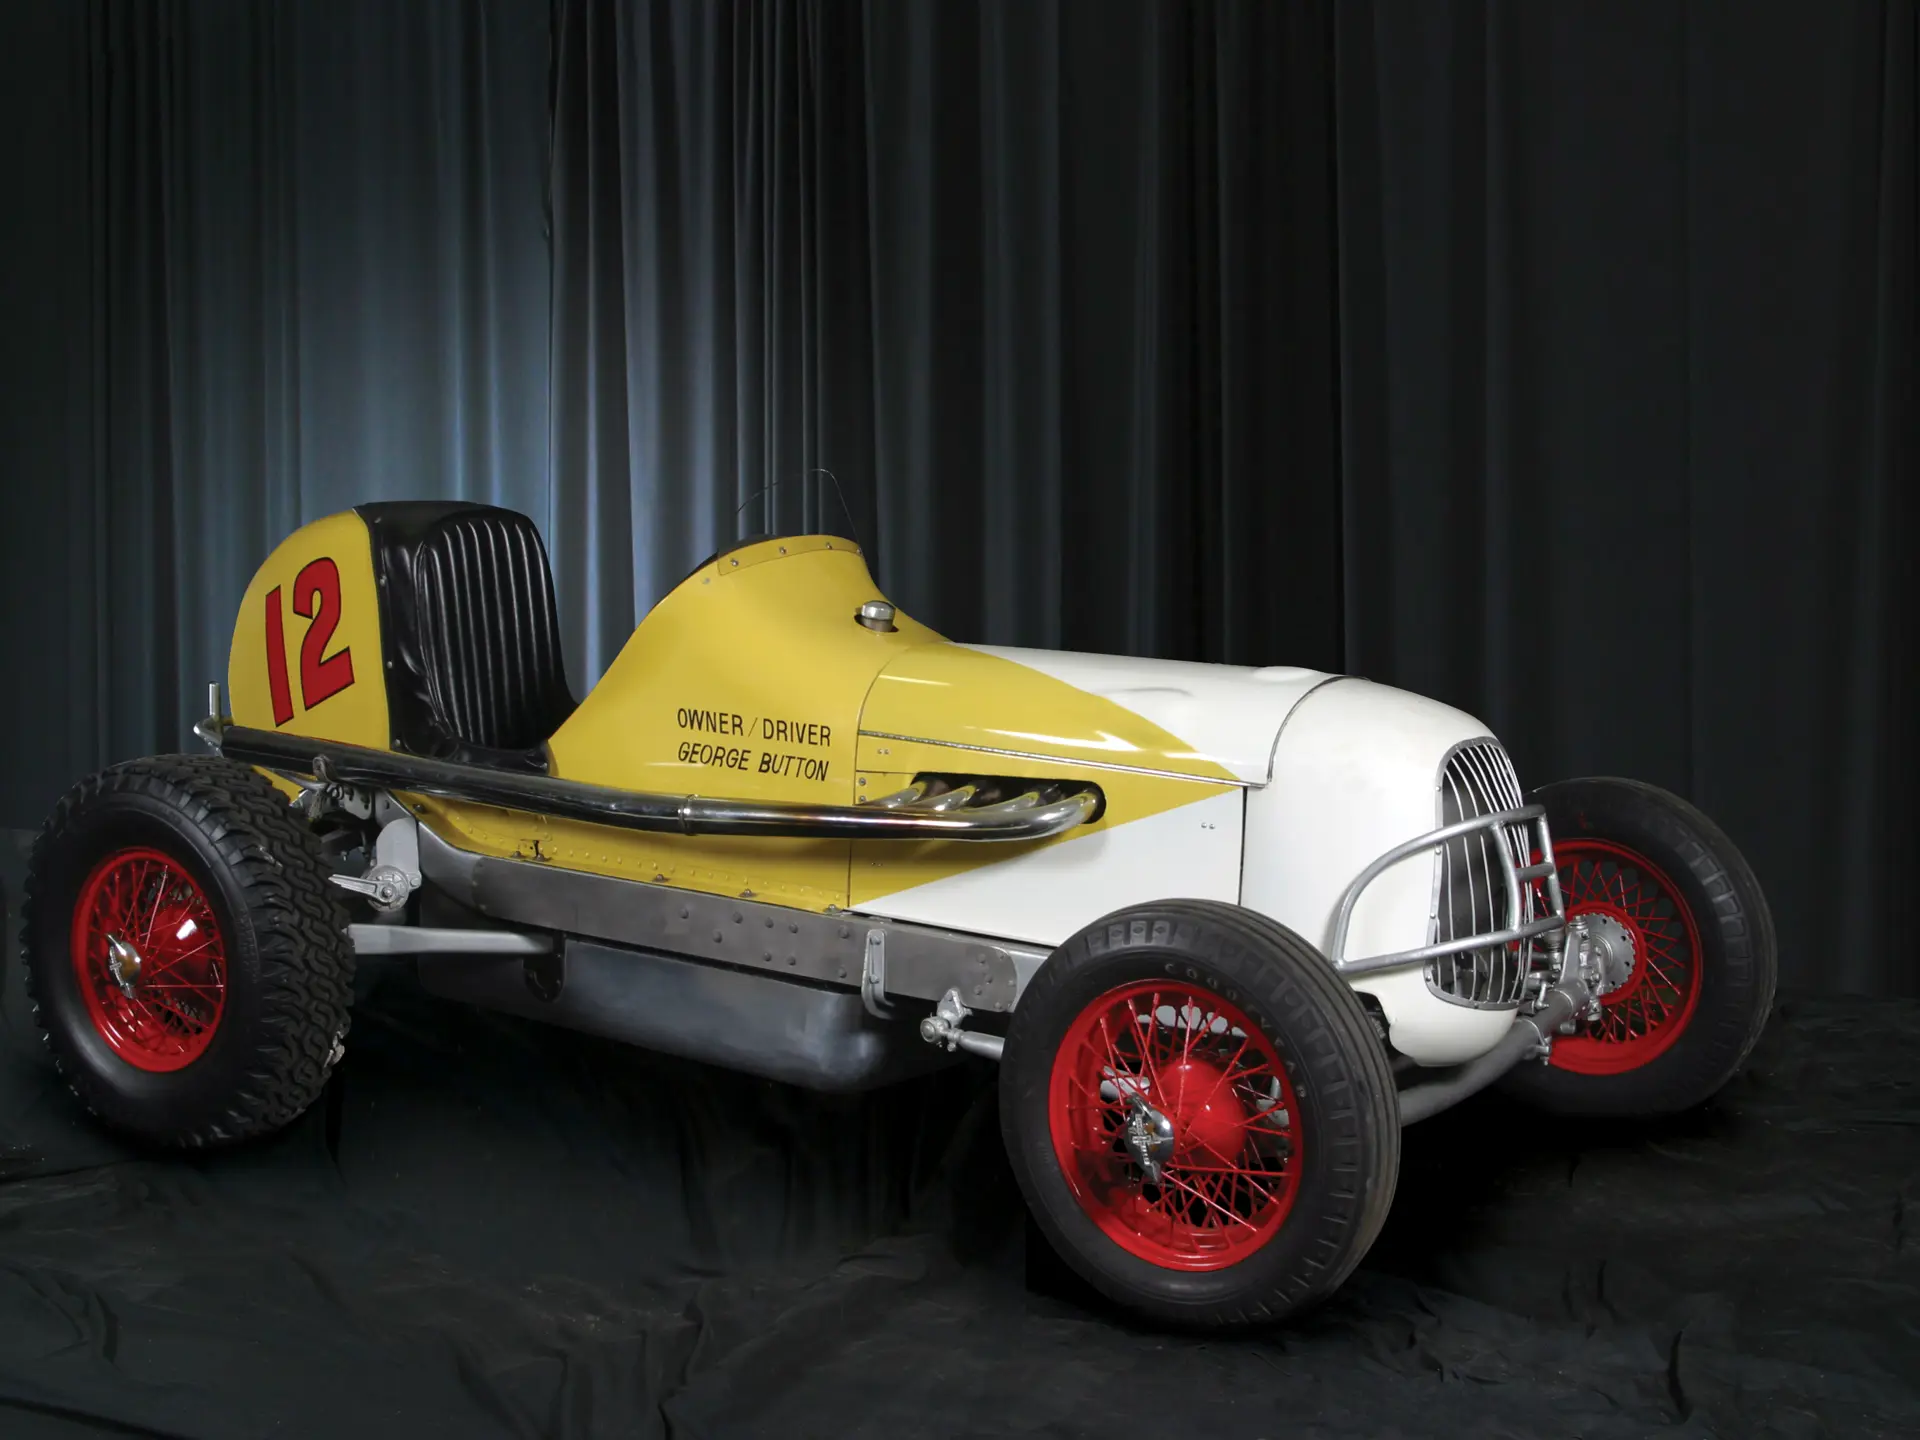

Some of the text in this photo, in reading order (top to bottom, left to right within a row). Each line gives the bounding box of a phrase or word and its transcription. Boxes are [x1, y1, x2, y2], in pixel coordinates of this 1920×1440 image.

[265, 556, 356, 728] 12
[677, 707, 744, 737] OWNER
[762, 718, 831, 747] DRIVER
[677, 741, 830, 782] GEORGE BUTTON
